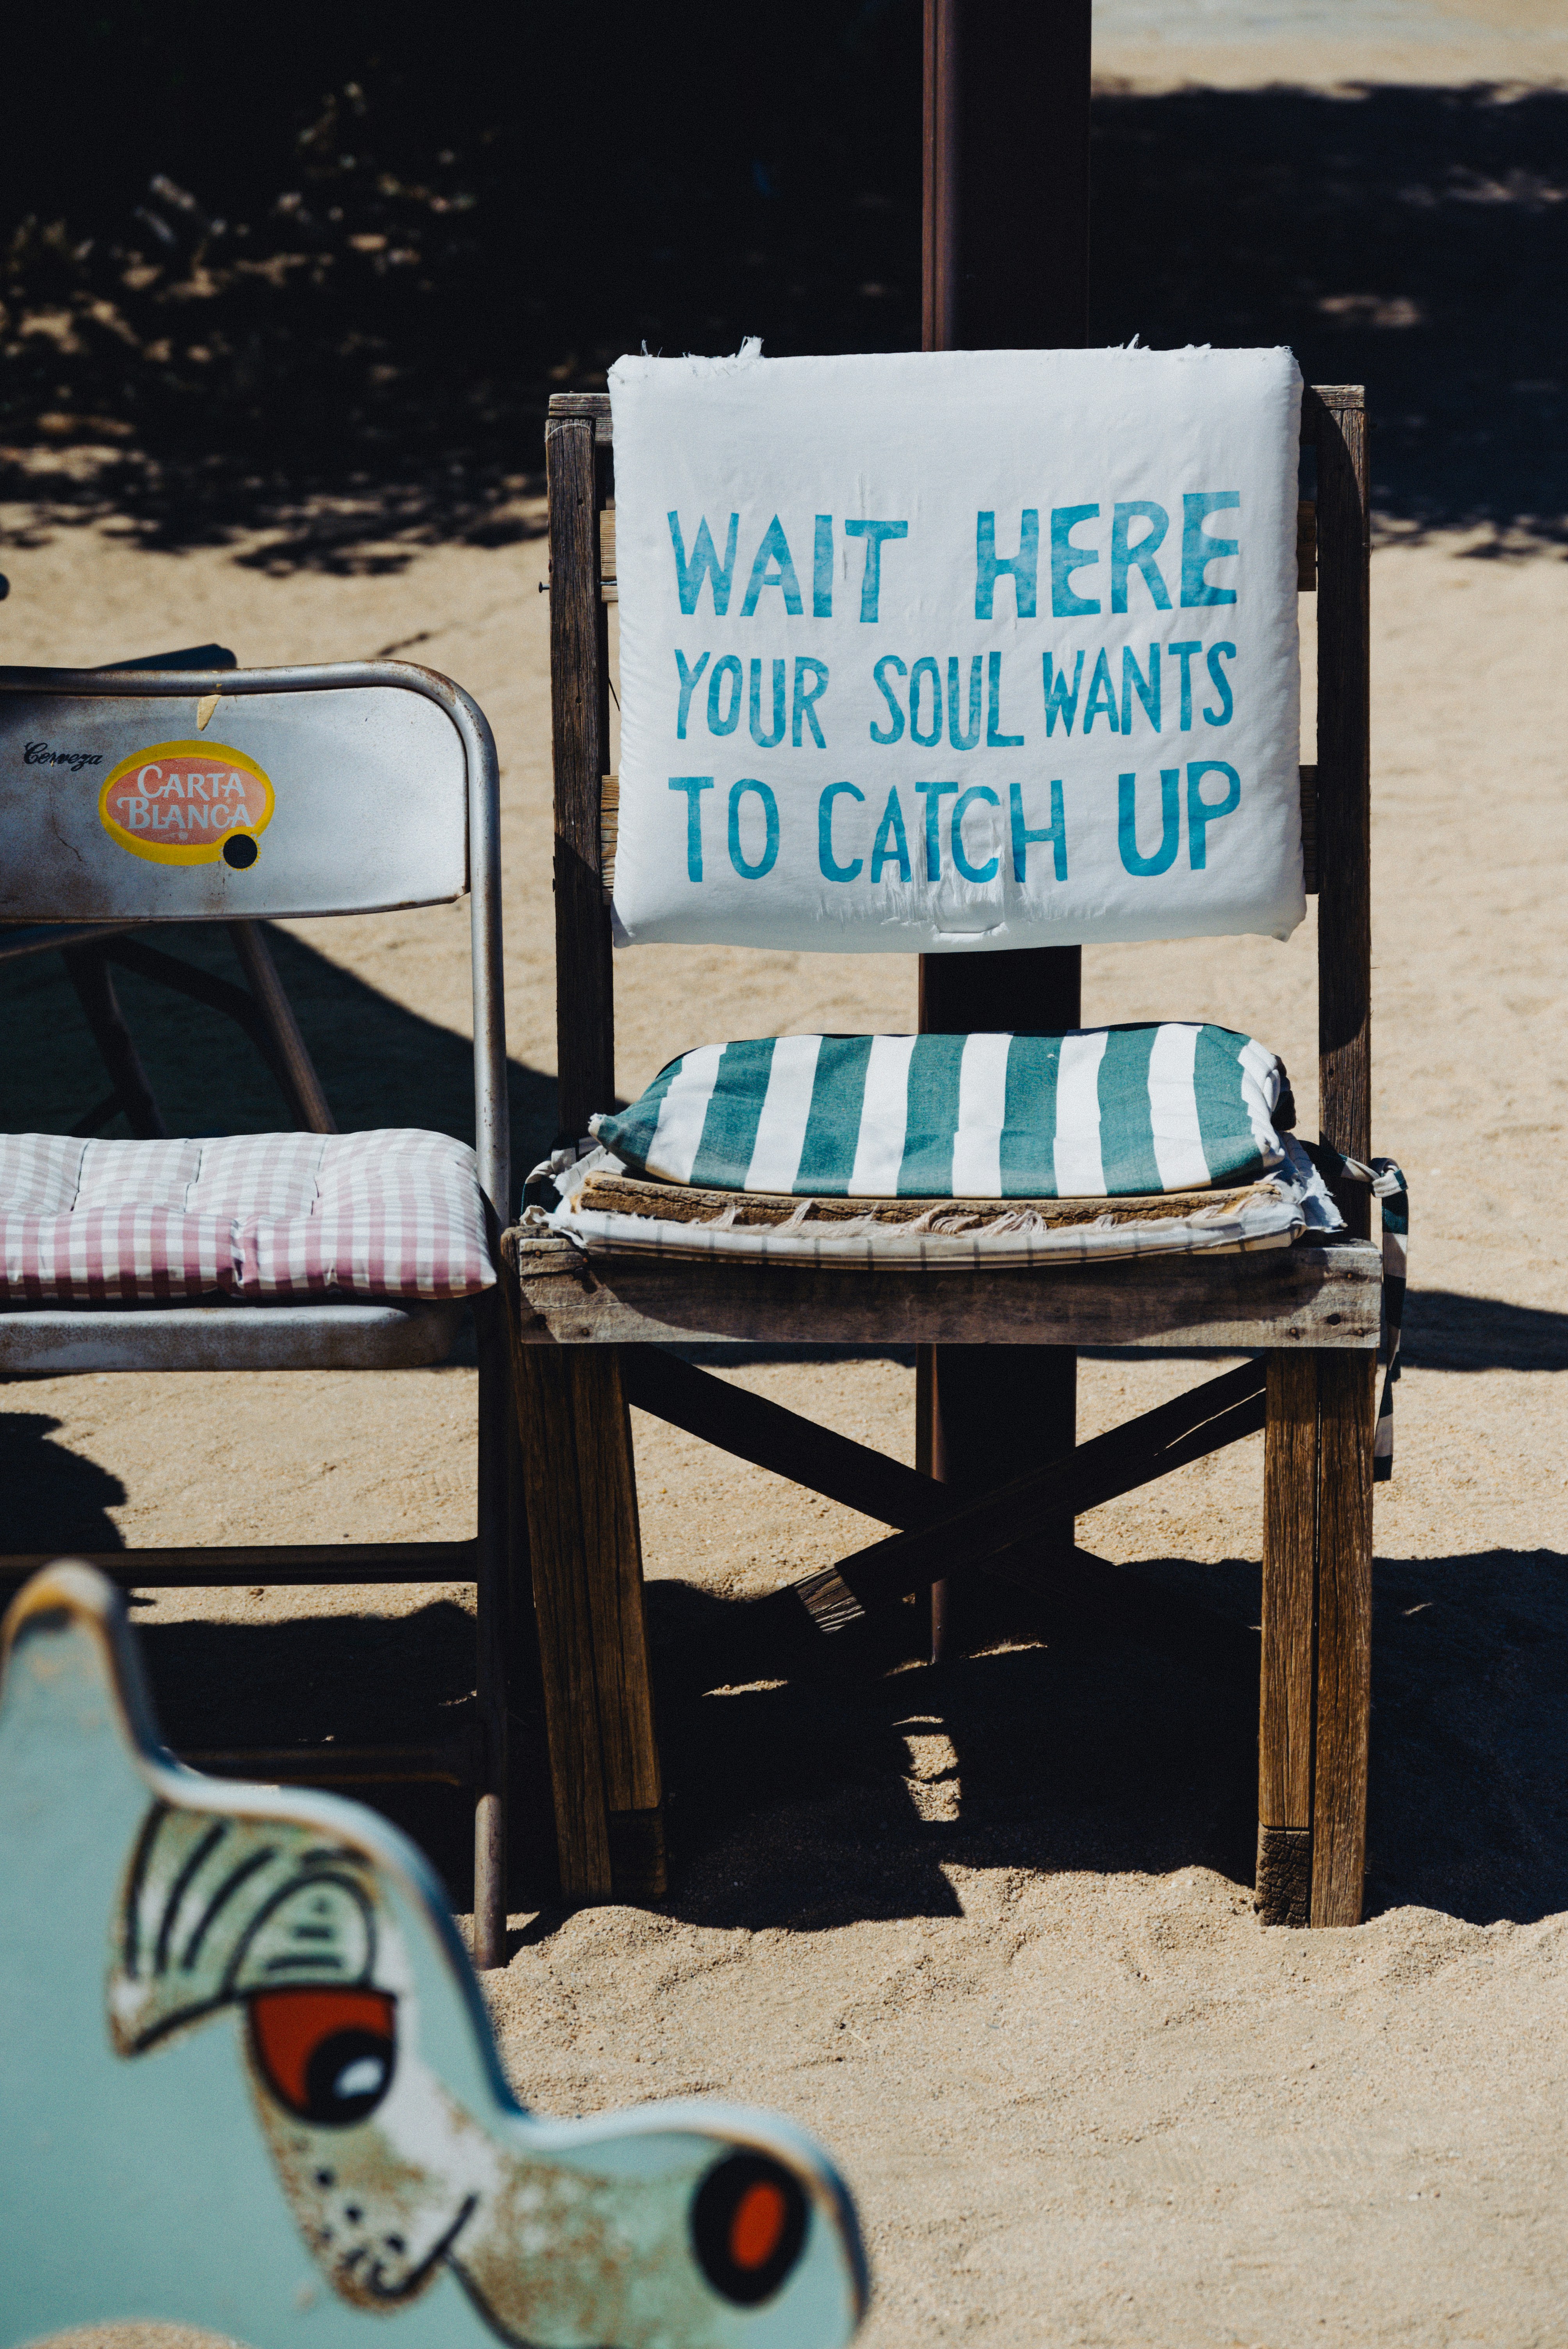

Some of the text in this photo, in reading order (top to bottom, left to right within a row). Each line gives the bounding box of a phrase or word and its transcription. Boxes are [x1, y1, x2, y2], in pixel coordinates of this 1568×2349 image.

[667, 491, 1240, 623] WAIT HERE
[674, 640, 1237, 751] YOUR SOUL WANTS
[23, 741, 103, 772] Cerveza
[137, 765, 246, 801] CARTA
[117, 797, 255, 829] BLANCA
[668, 760, 1241, 884] TO CATCH UP
